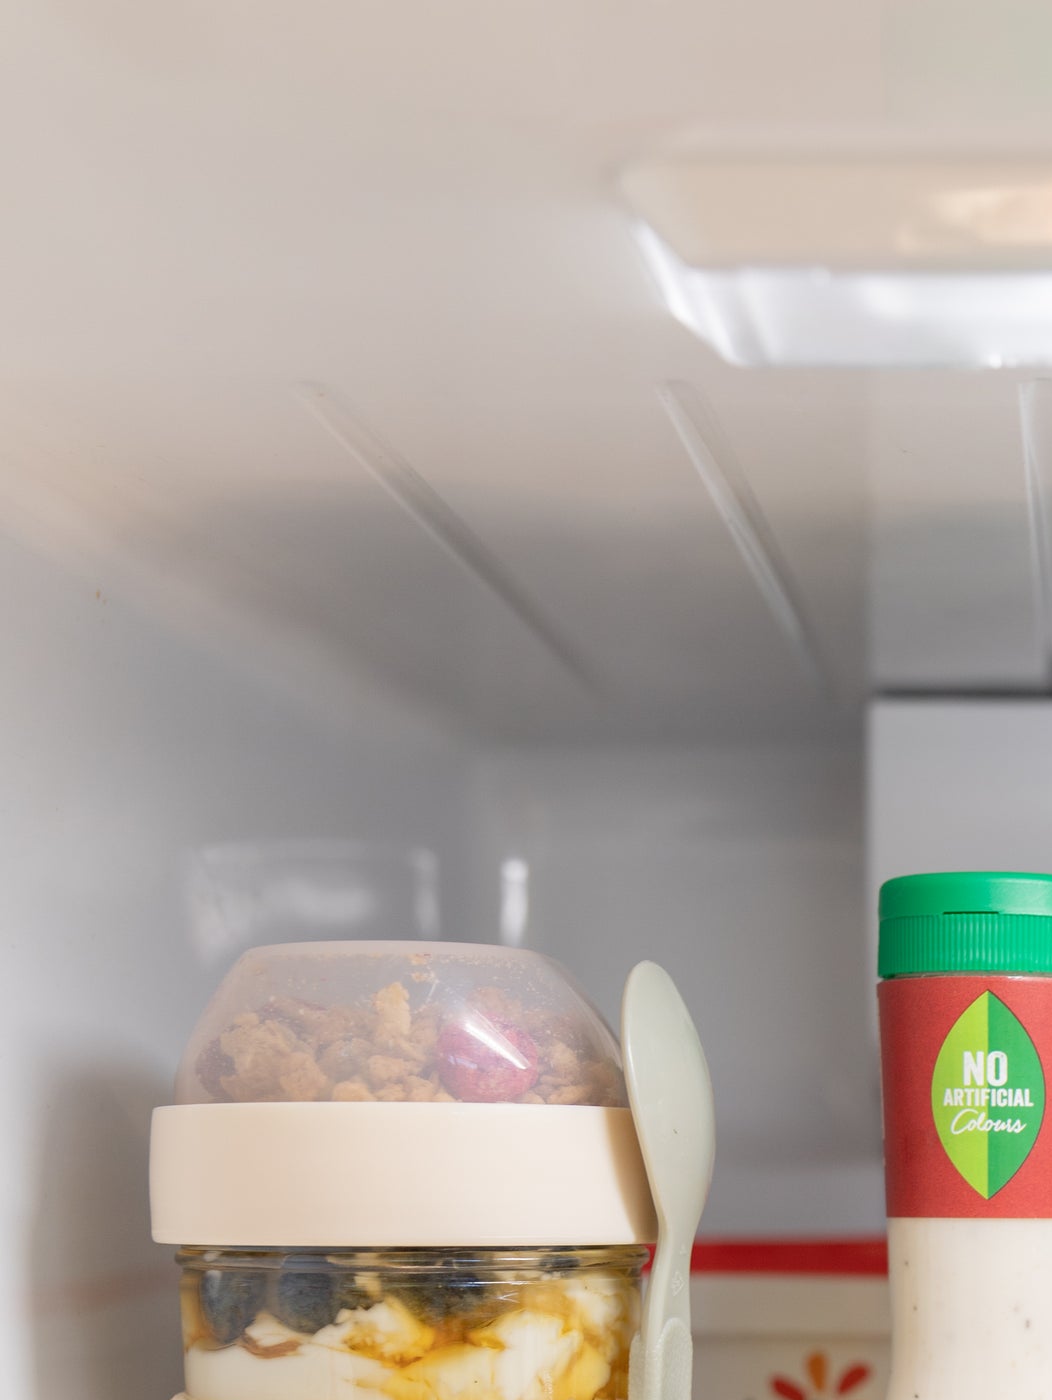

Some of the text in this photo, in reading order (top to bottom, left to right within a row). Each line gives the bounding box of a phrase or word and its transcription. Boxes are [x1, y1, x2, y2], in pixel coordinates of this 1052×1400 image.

[963, 1051, 1008, 1087] NO
[943, 1087, 1034, 1107] ARTIFICIAL
[950, 1108, 1027, 1135] Colours
